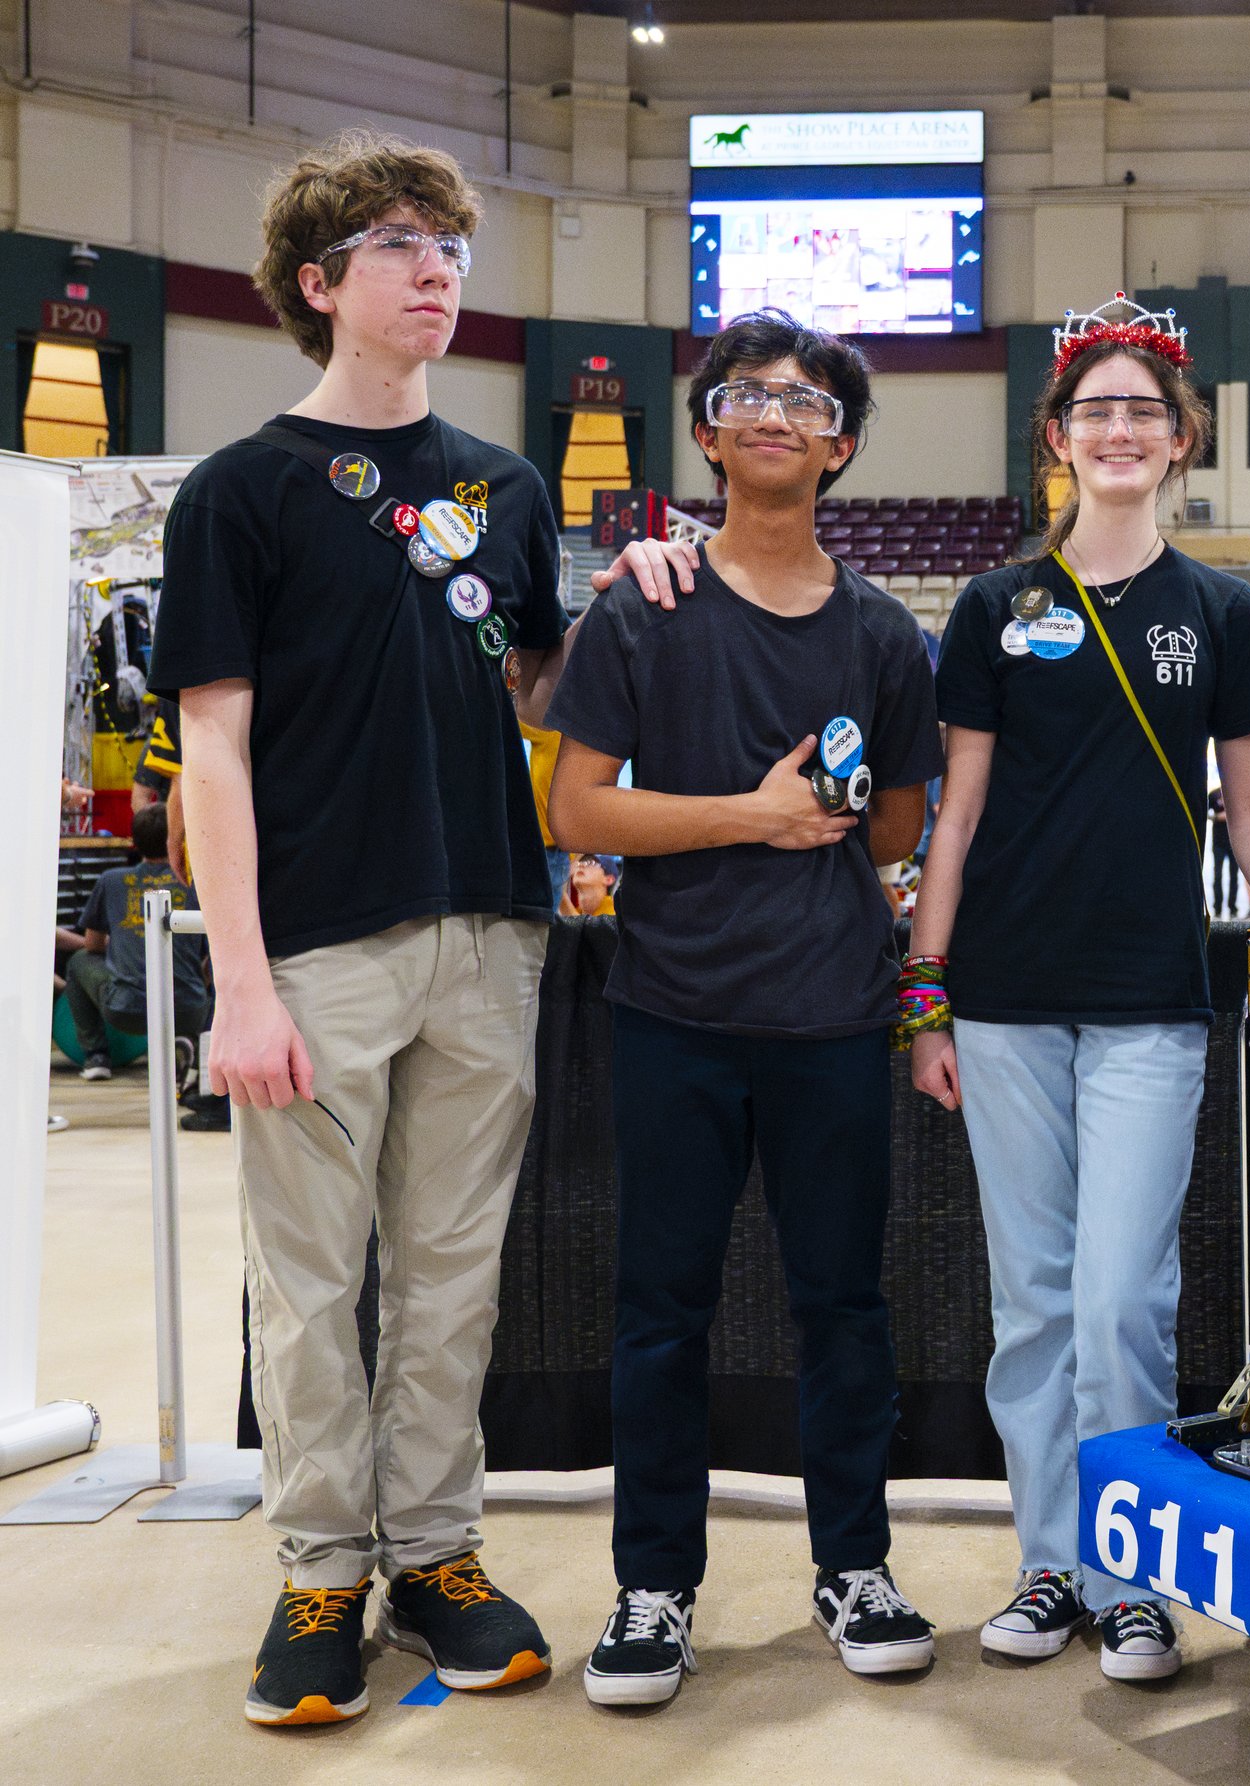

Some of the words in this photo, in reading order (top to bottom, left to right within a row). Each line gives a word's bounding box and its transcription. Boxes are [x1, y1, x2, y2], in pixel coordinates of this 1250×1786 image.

[786, 121, 845, 137] SHOW
[848, 120, 907, 136] PLACE
[909, 119, 970, 135] ARENA
[49, 303, 103, 334] P20
[578, 377, 621, 401] P19
[438, 508, 472, 547] REEFSCAPE
[1051, 609, 1068, 619] 611
[1036, 621, 1078, 633] REEFSCAPE
[1156, 662, 1194, 687] 611
[830, 721, 842, 736] 611
[827, 728, 855, 756] REEFSCAPE
[1095, 1480, 1250, 1636] 611
